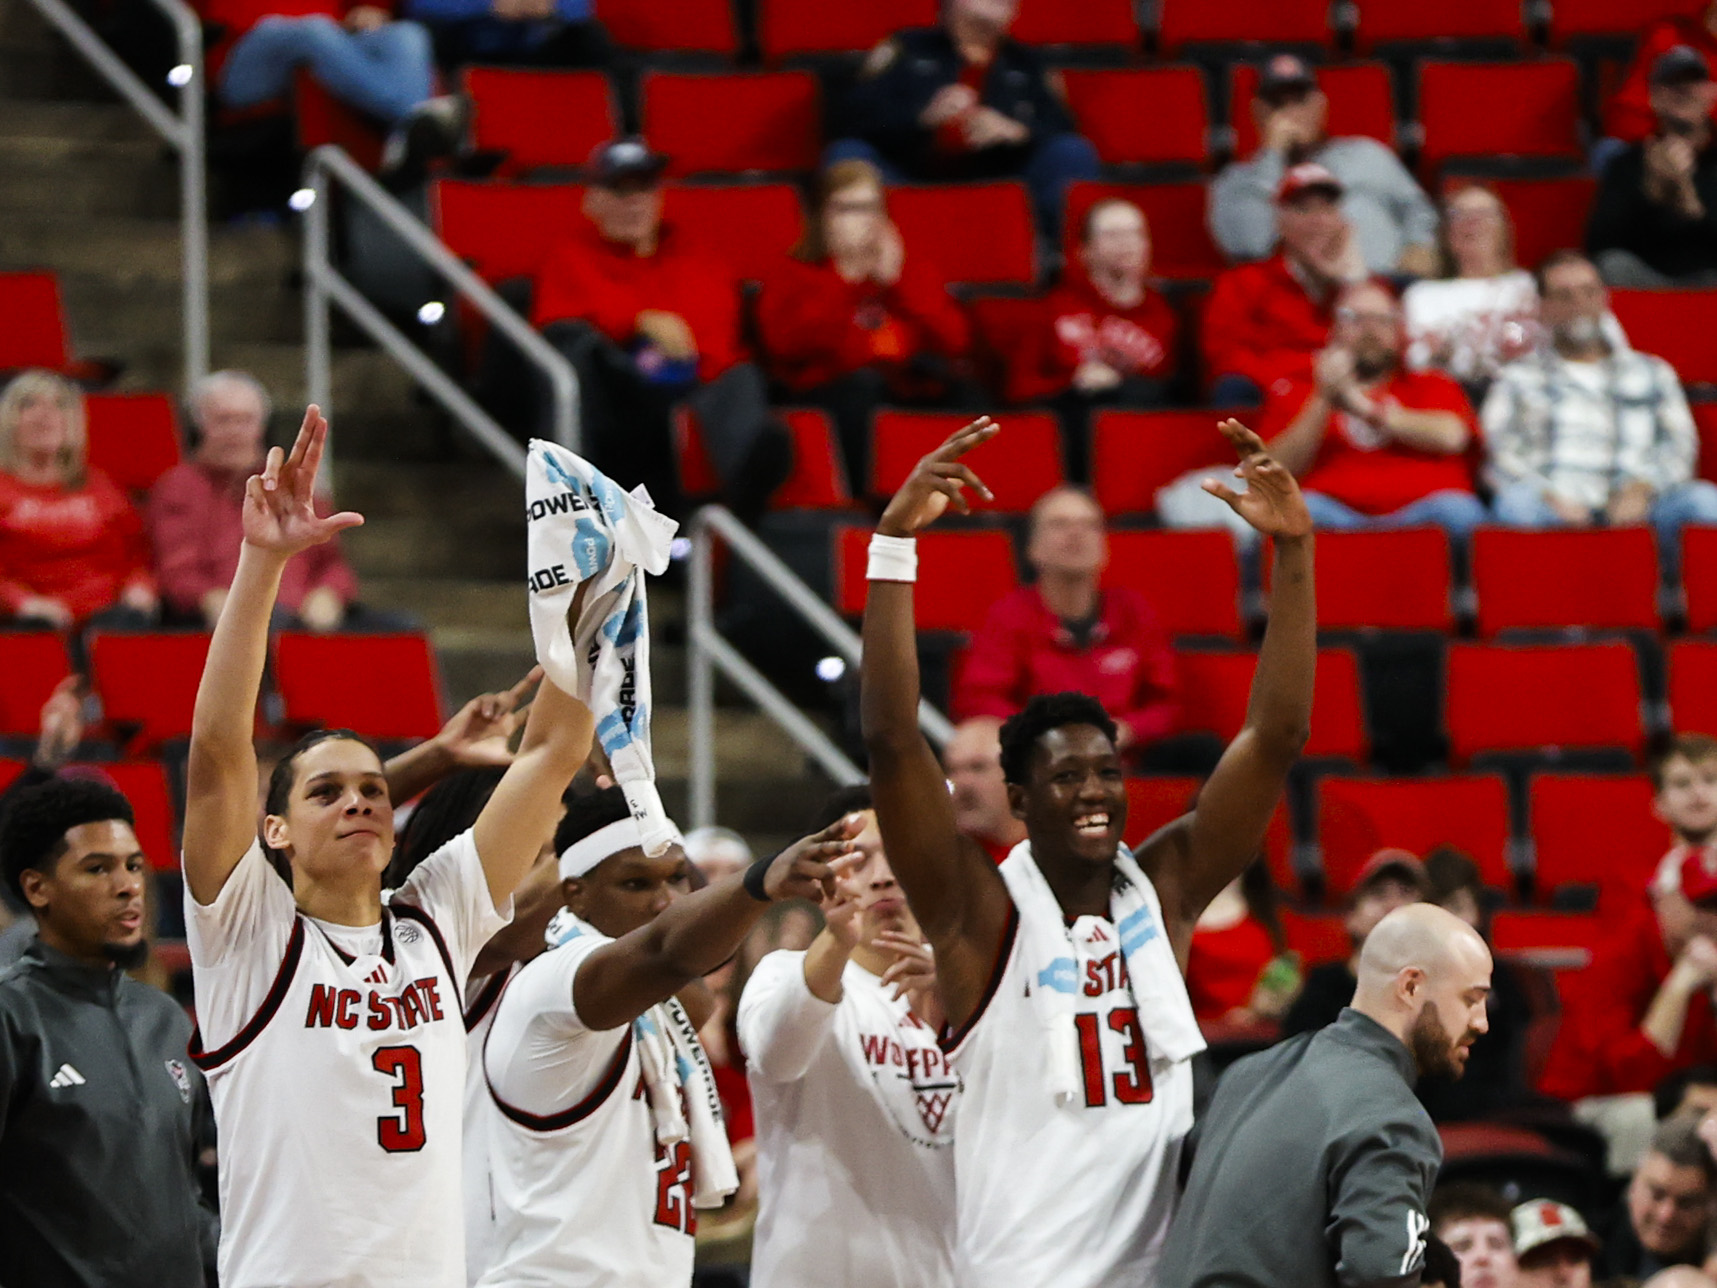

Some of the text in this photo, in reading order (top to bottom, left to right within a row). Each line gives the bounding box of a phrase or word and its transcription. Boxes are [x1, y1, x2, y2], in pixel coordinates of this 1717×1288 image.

[305, 976, 444, 1031] NC STATE
[371, 1044, 426, 1153] 3
[1074, 1006, 1154, 1107] 13
